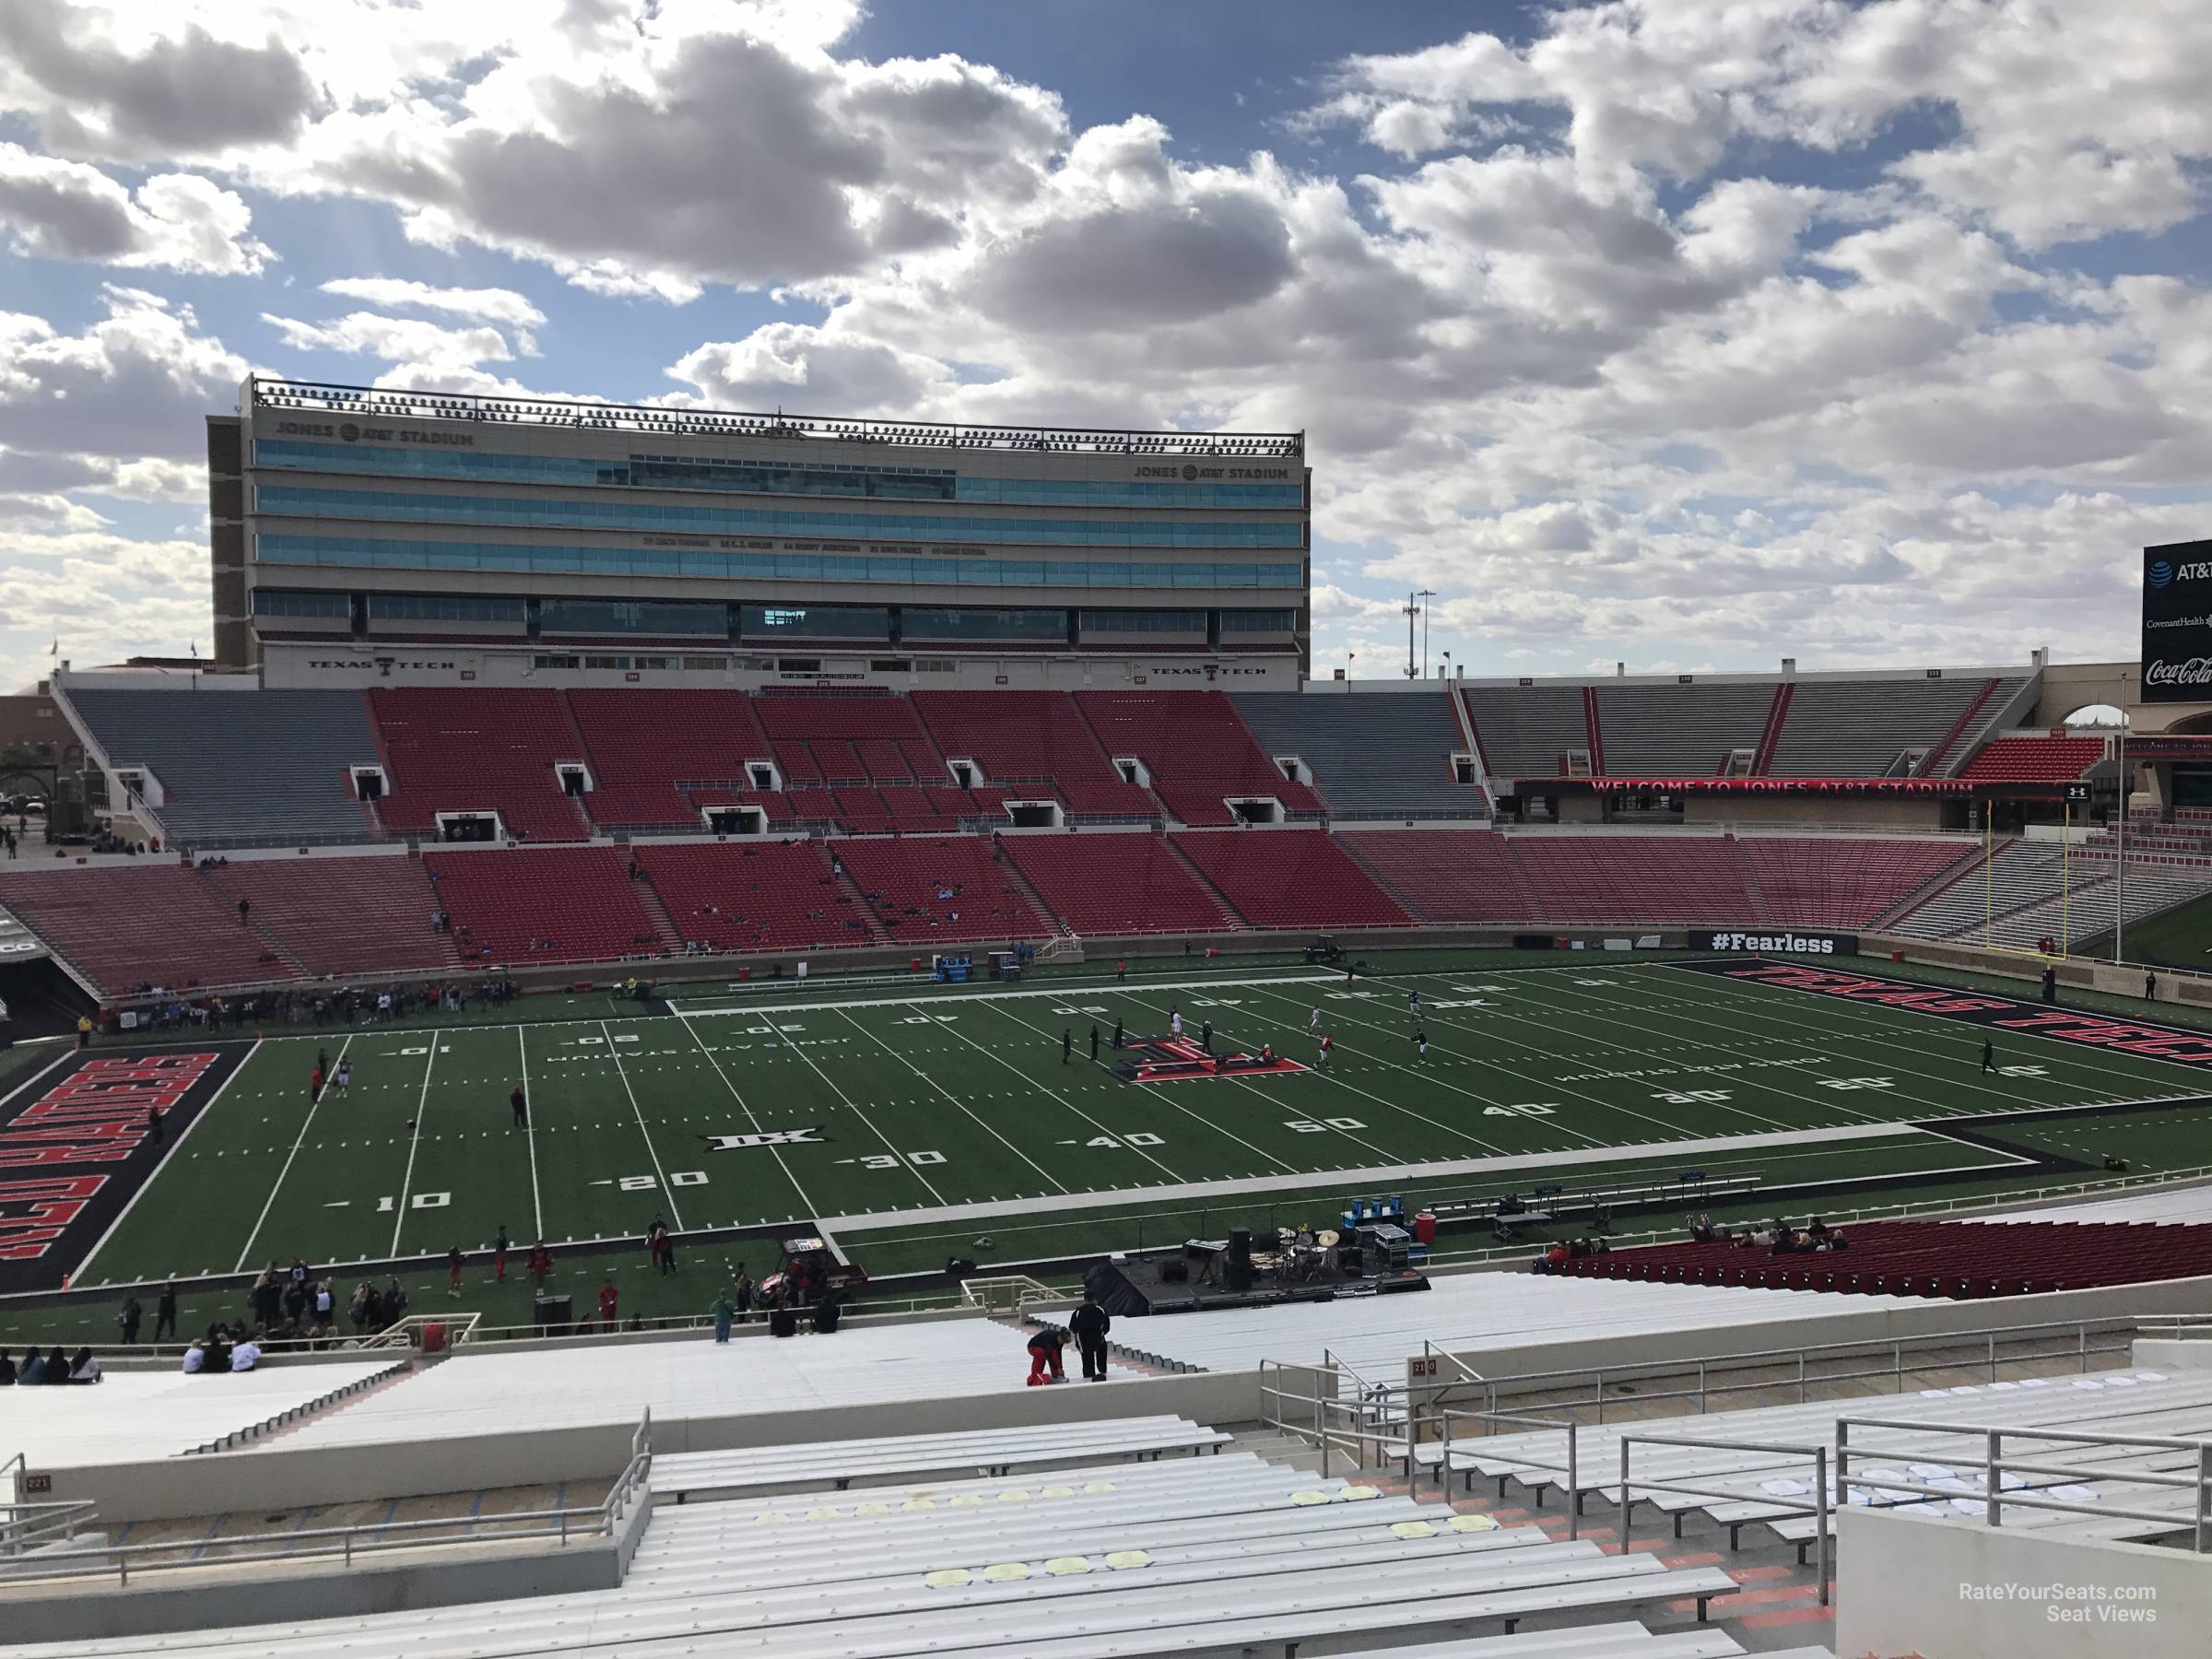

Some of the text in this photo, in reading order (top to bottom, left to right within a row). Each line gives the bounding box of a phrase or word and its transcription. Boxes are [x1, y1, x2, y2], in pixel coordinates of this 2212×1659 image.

[276, 422, 334, 437] JONES
[400, 430, 474, 445] STADIUM
[1135, 466, 1288, 478] JONES AT&T STADIUM
[308, 661, 371, 669] TEXAS
[1712, 933, 1834, 955] #Fearless
[1724, 965, 2212, 1067] TEXAS TEC
[1815, 1077, 1896, 1090] 20
[1650, 1090, 1733, 1104] 30
[1482, 1104, 1557, 1117] 40
[1283, 1117, 1368, 1133] 50
[1086, 1133, 1166, 1148] 40
[859, 1150, 947, 1170] 30
[618, 1171, 710, 1191] 20
[376, 1192, 451, 1212] 10
